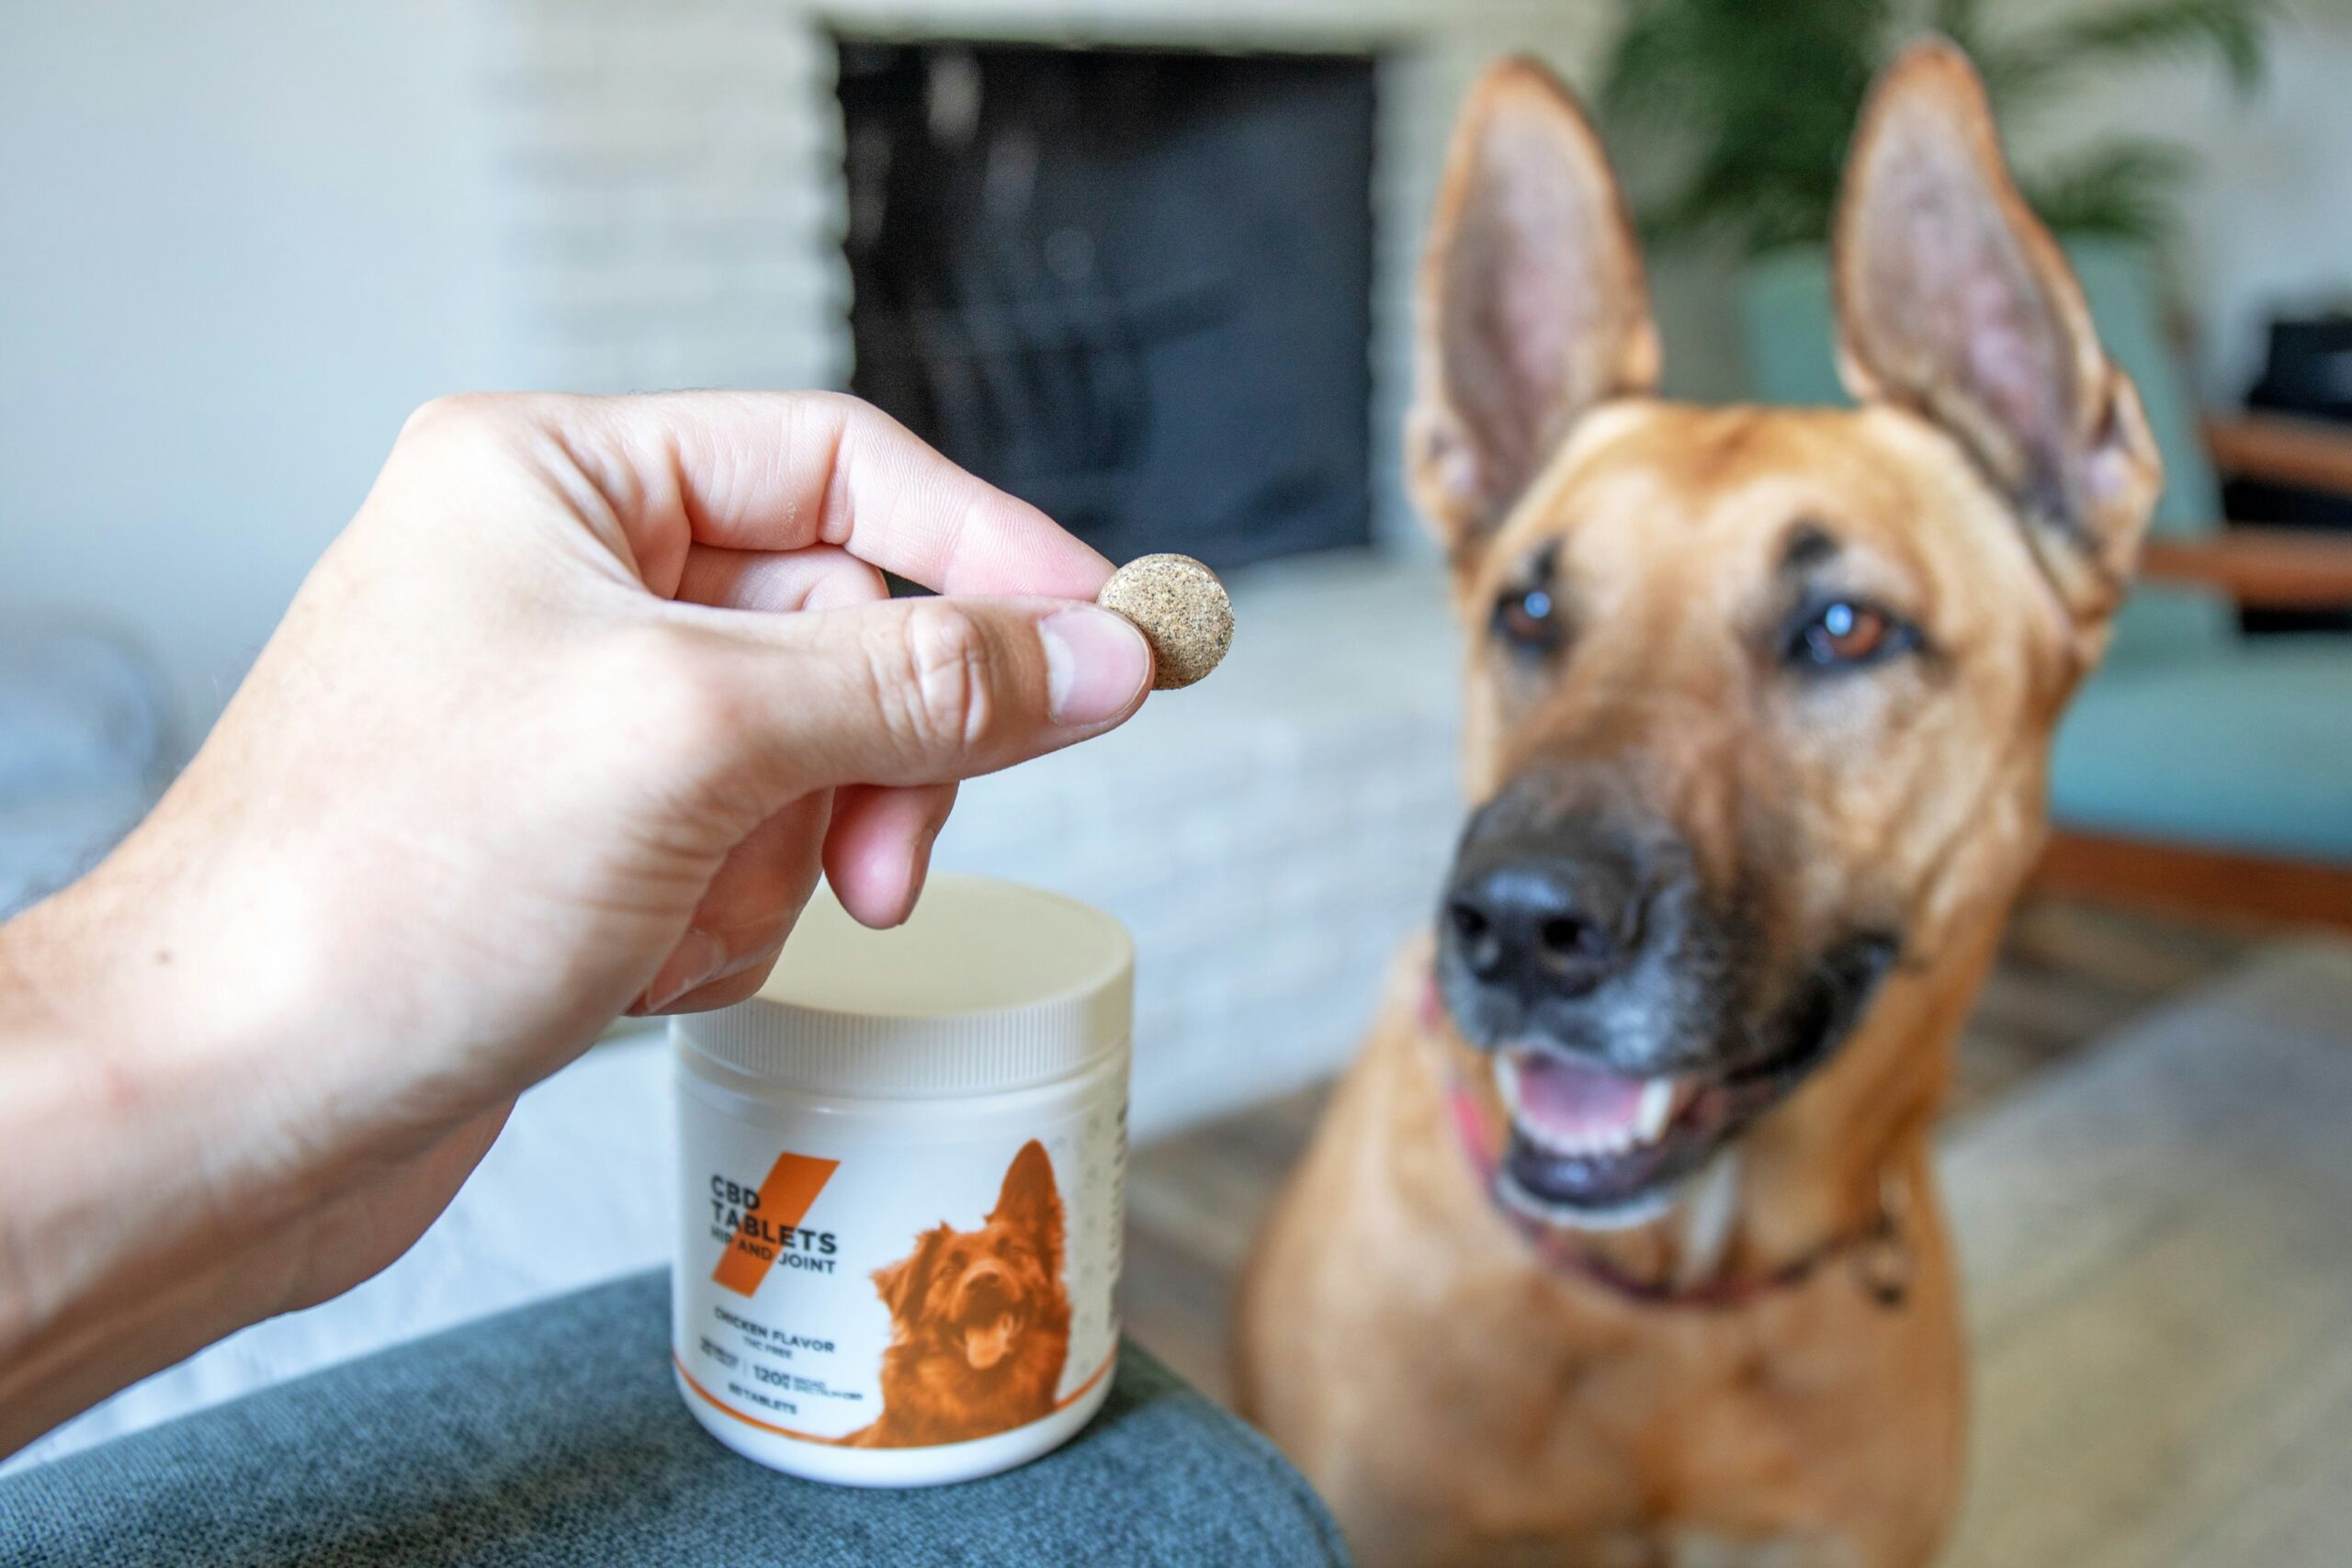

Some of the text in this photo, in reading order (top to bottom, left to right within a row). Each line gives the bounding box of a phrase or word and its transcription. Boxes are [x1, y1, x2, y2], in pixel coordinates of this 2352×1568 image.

[711, 1175, 760, 1210] CBD
[711, 1199, 837, 1255] TABLETS
[711, 1225, 835, 1274] HIP AND JOINT
[715, 1306, 835, 1353] CHICKEN FLAVOR
[743, 1336, 792, 1359] THC FREE
[743, 1388, 797, 1415] TABLETS
